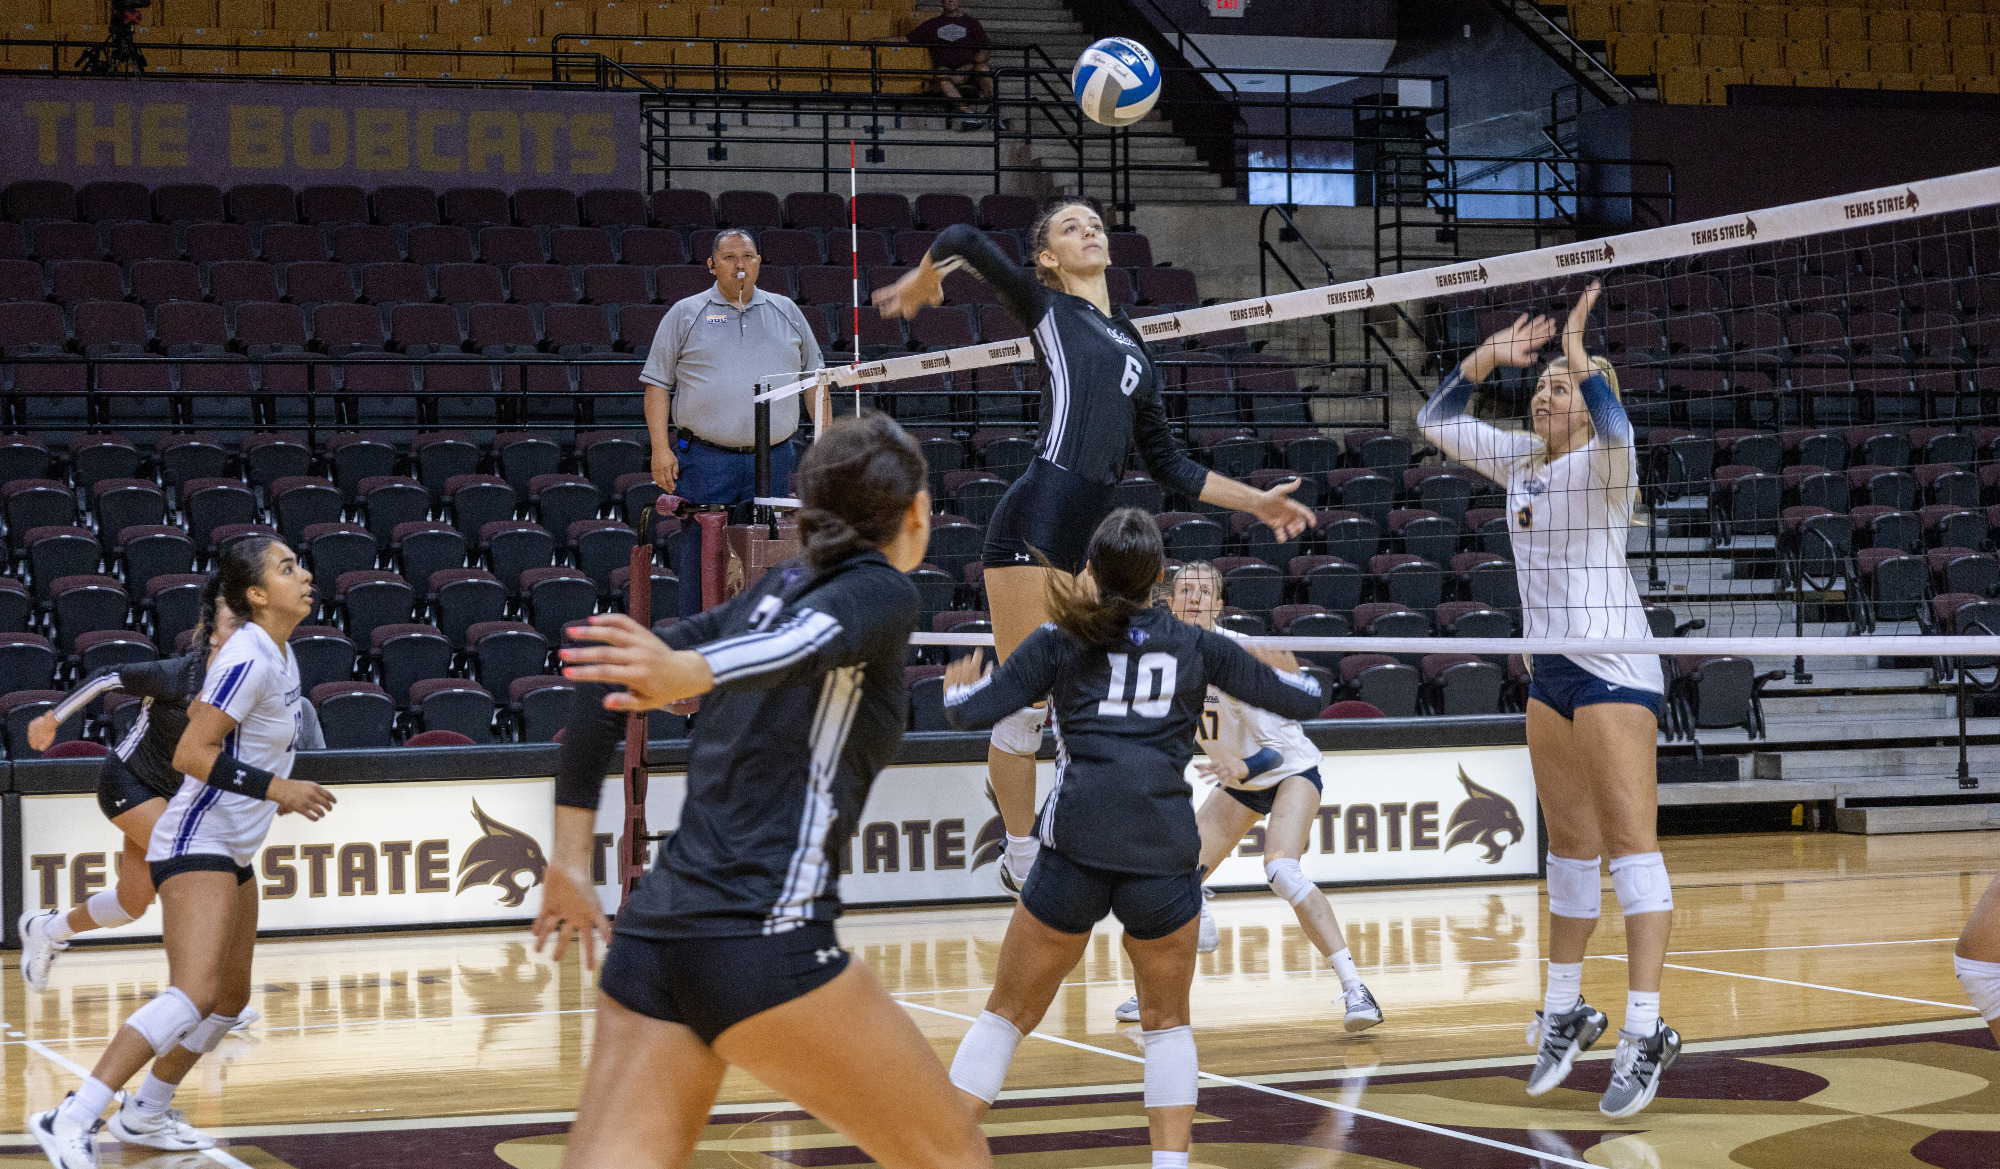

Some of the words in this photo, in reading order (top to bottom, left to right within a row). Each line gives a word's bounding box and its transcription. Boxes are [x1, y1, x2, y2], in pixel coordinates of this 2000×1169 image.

[25, 101, 189, 167] THE
[229, 105, 616, 174] BOBCATS
[1844, 200, 1876, 220] TEXAS
[1876, 196, 1905, 214] STATE
[1691, 228, 1719, 246] TEXAS
[1719, 223, 1745, 241] STATE
[1555, 253, 1580, 268] TEXAS
[1580, 248, 1604, 264] STATE
[1435, 273, 1457, 288] TEXAS
[1457, 269, 1478, 284] STATE
[1327, 291, 1347, 306] TEXAS
[1347, 288, 1366, 303] STATE
[1229, 308, 1248, 321] TEXAS
[1248, 305, 1265, 319] STATE
[1141, 323, 1158, 336] TEXAS
[1158, 321, 1174, 334] STATE
[988, 348, 1002, 359] TEXAS
[1002, 346, 1015, 357] STATE
[857, 368, 870, 378] TEXAS
[870, 366, 882, 377] STATE
[920, 359, 934, 370] TEXAS
[934, 357, 945, 368] STATE
[1120, 354, 1142, 397] 6
[1098, 651, 1178, 718] 10
[1303, 801, 1440, 855] TATE
[261, 839, 450, 900] STATE
